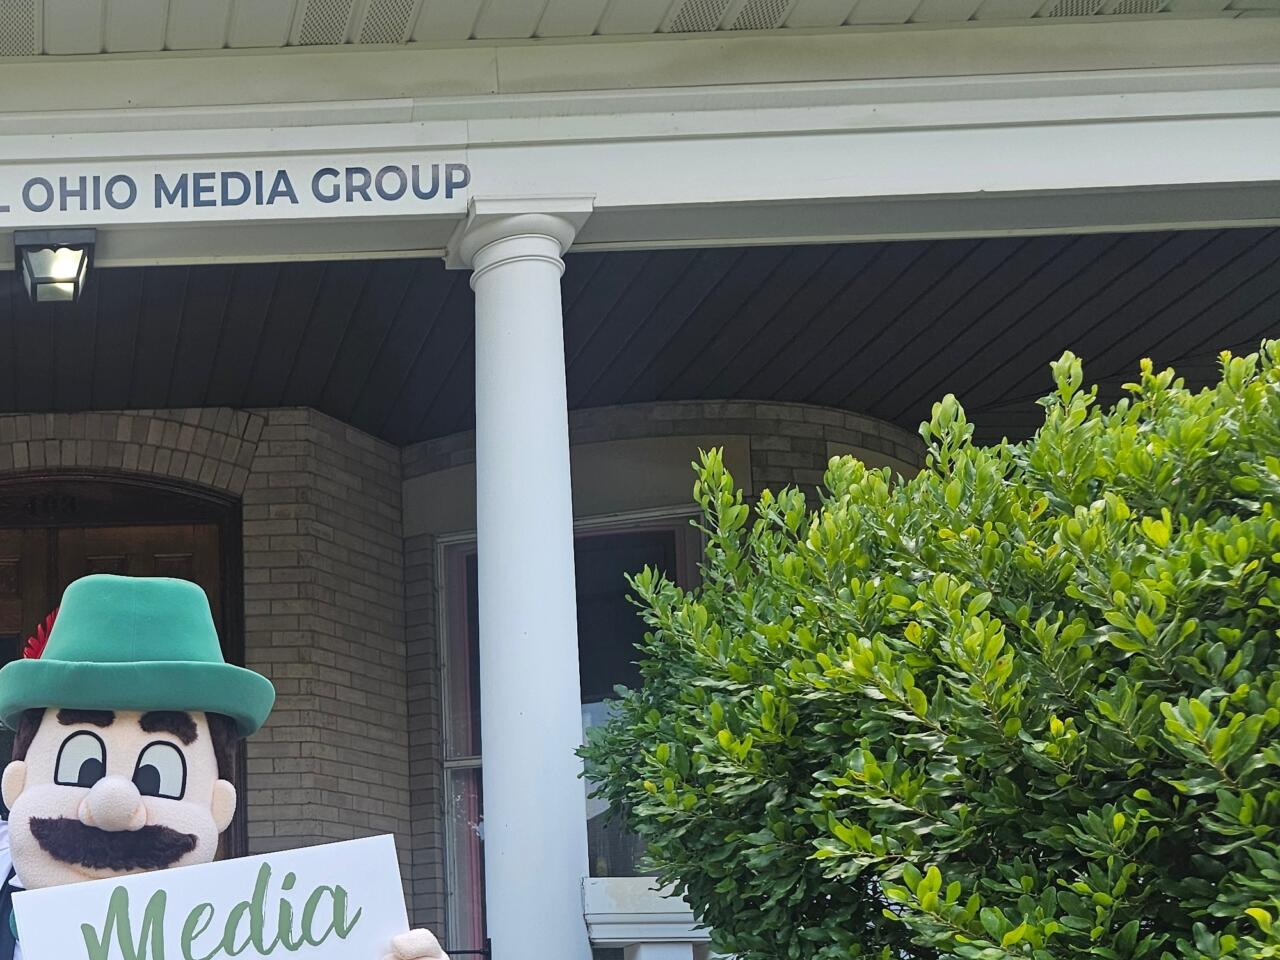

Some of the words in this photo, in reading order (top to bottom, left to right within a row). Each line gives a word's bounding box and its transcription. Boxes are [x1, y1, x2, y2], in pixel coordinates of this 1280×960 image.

[22, 174, 137, 213] OHIO
[154, 169, 299, 208] MEDIA
[311, 163, 471, 203] GROUP
